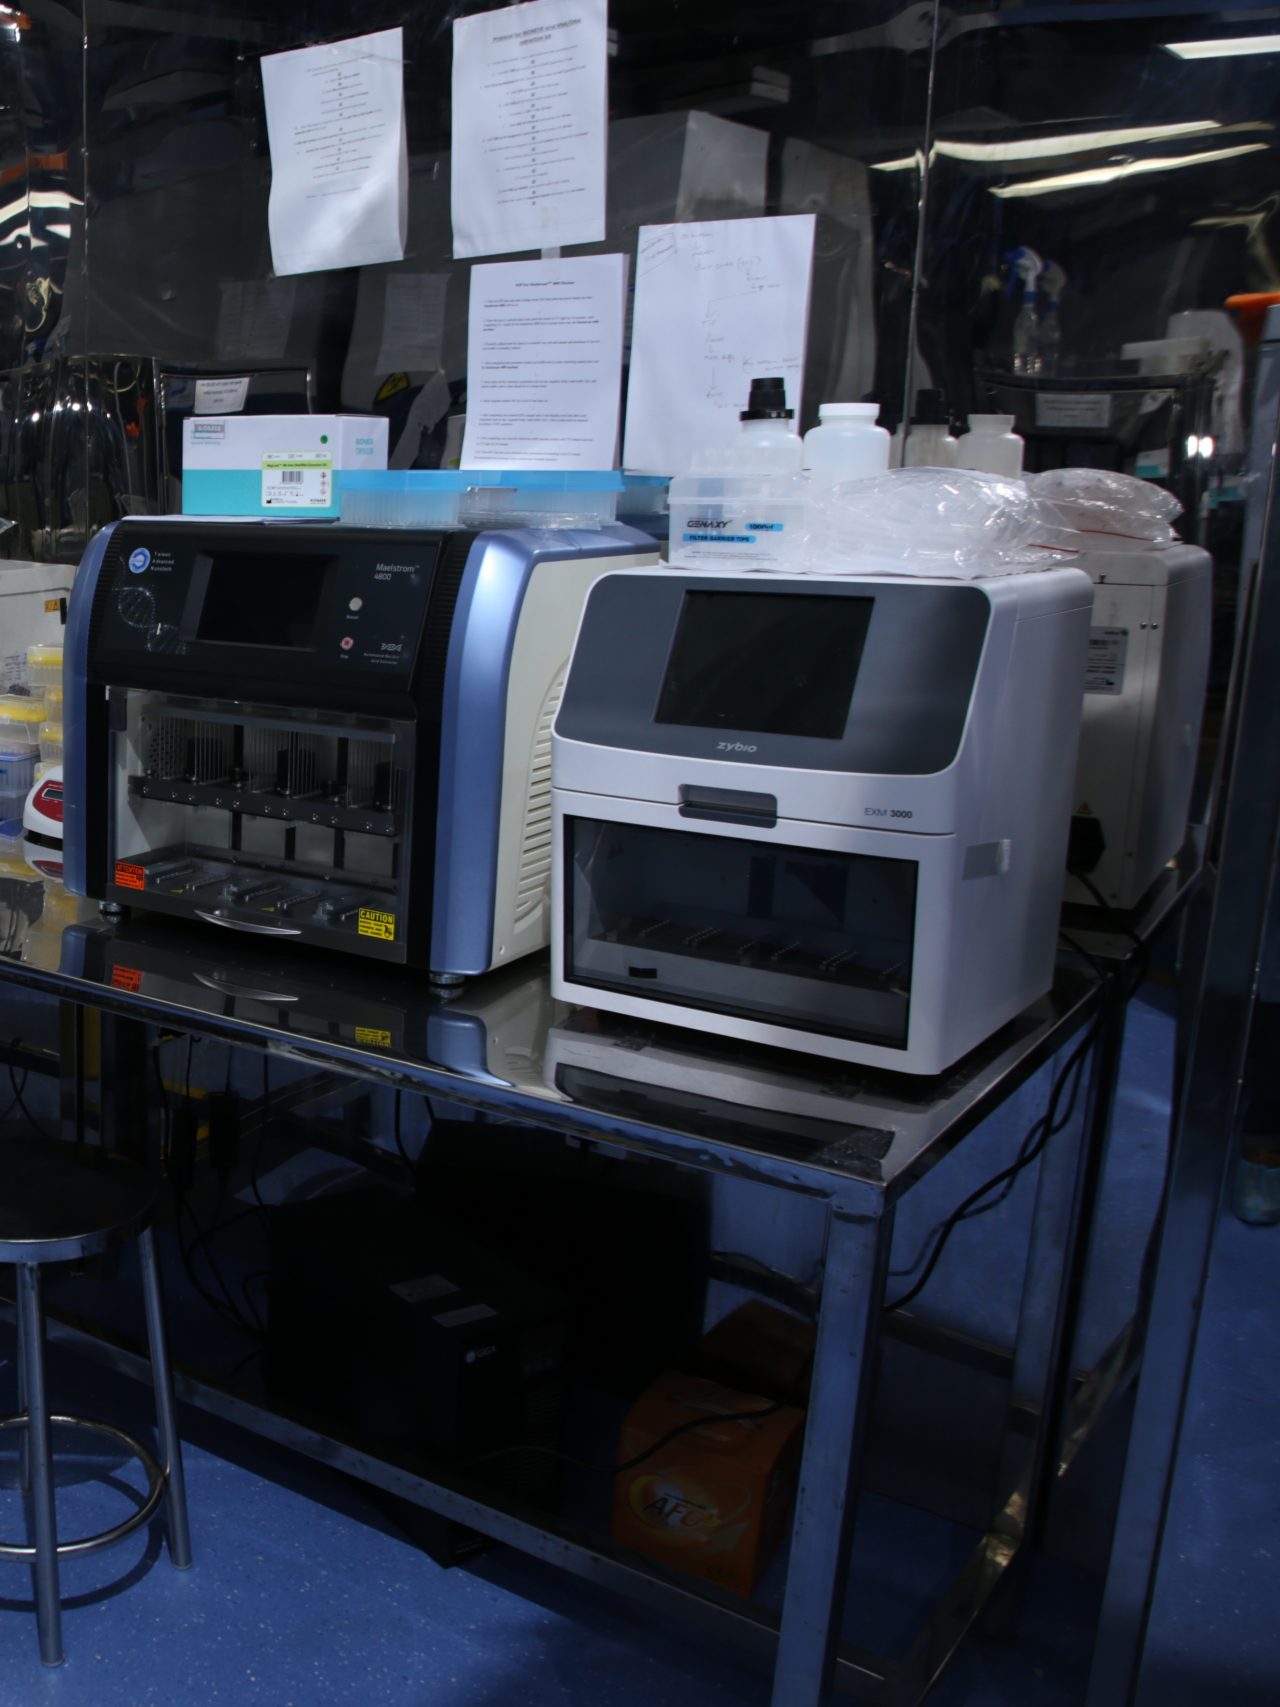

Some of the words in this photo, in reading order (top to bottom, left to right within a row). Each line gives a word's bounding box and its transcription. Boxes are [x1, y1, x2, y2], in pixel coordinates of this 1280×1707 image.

[687, 519, 731, 529] GENAXY
[373, 572, 392, 581] 4800
[716, 741, 758, 753] zybio
[889, 809, 913, 819] 3000
[360, 910, 393, 924] CAUTION
